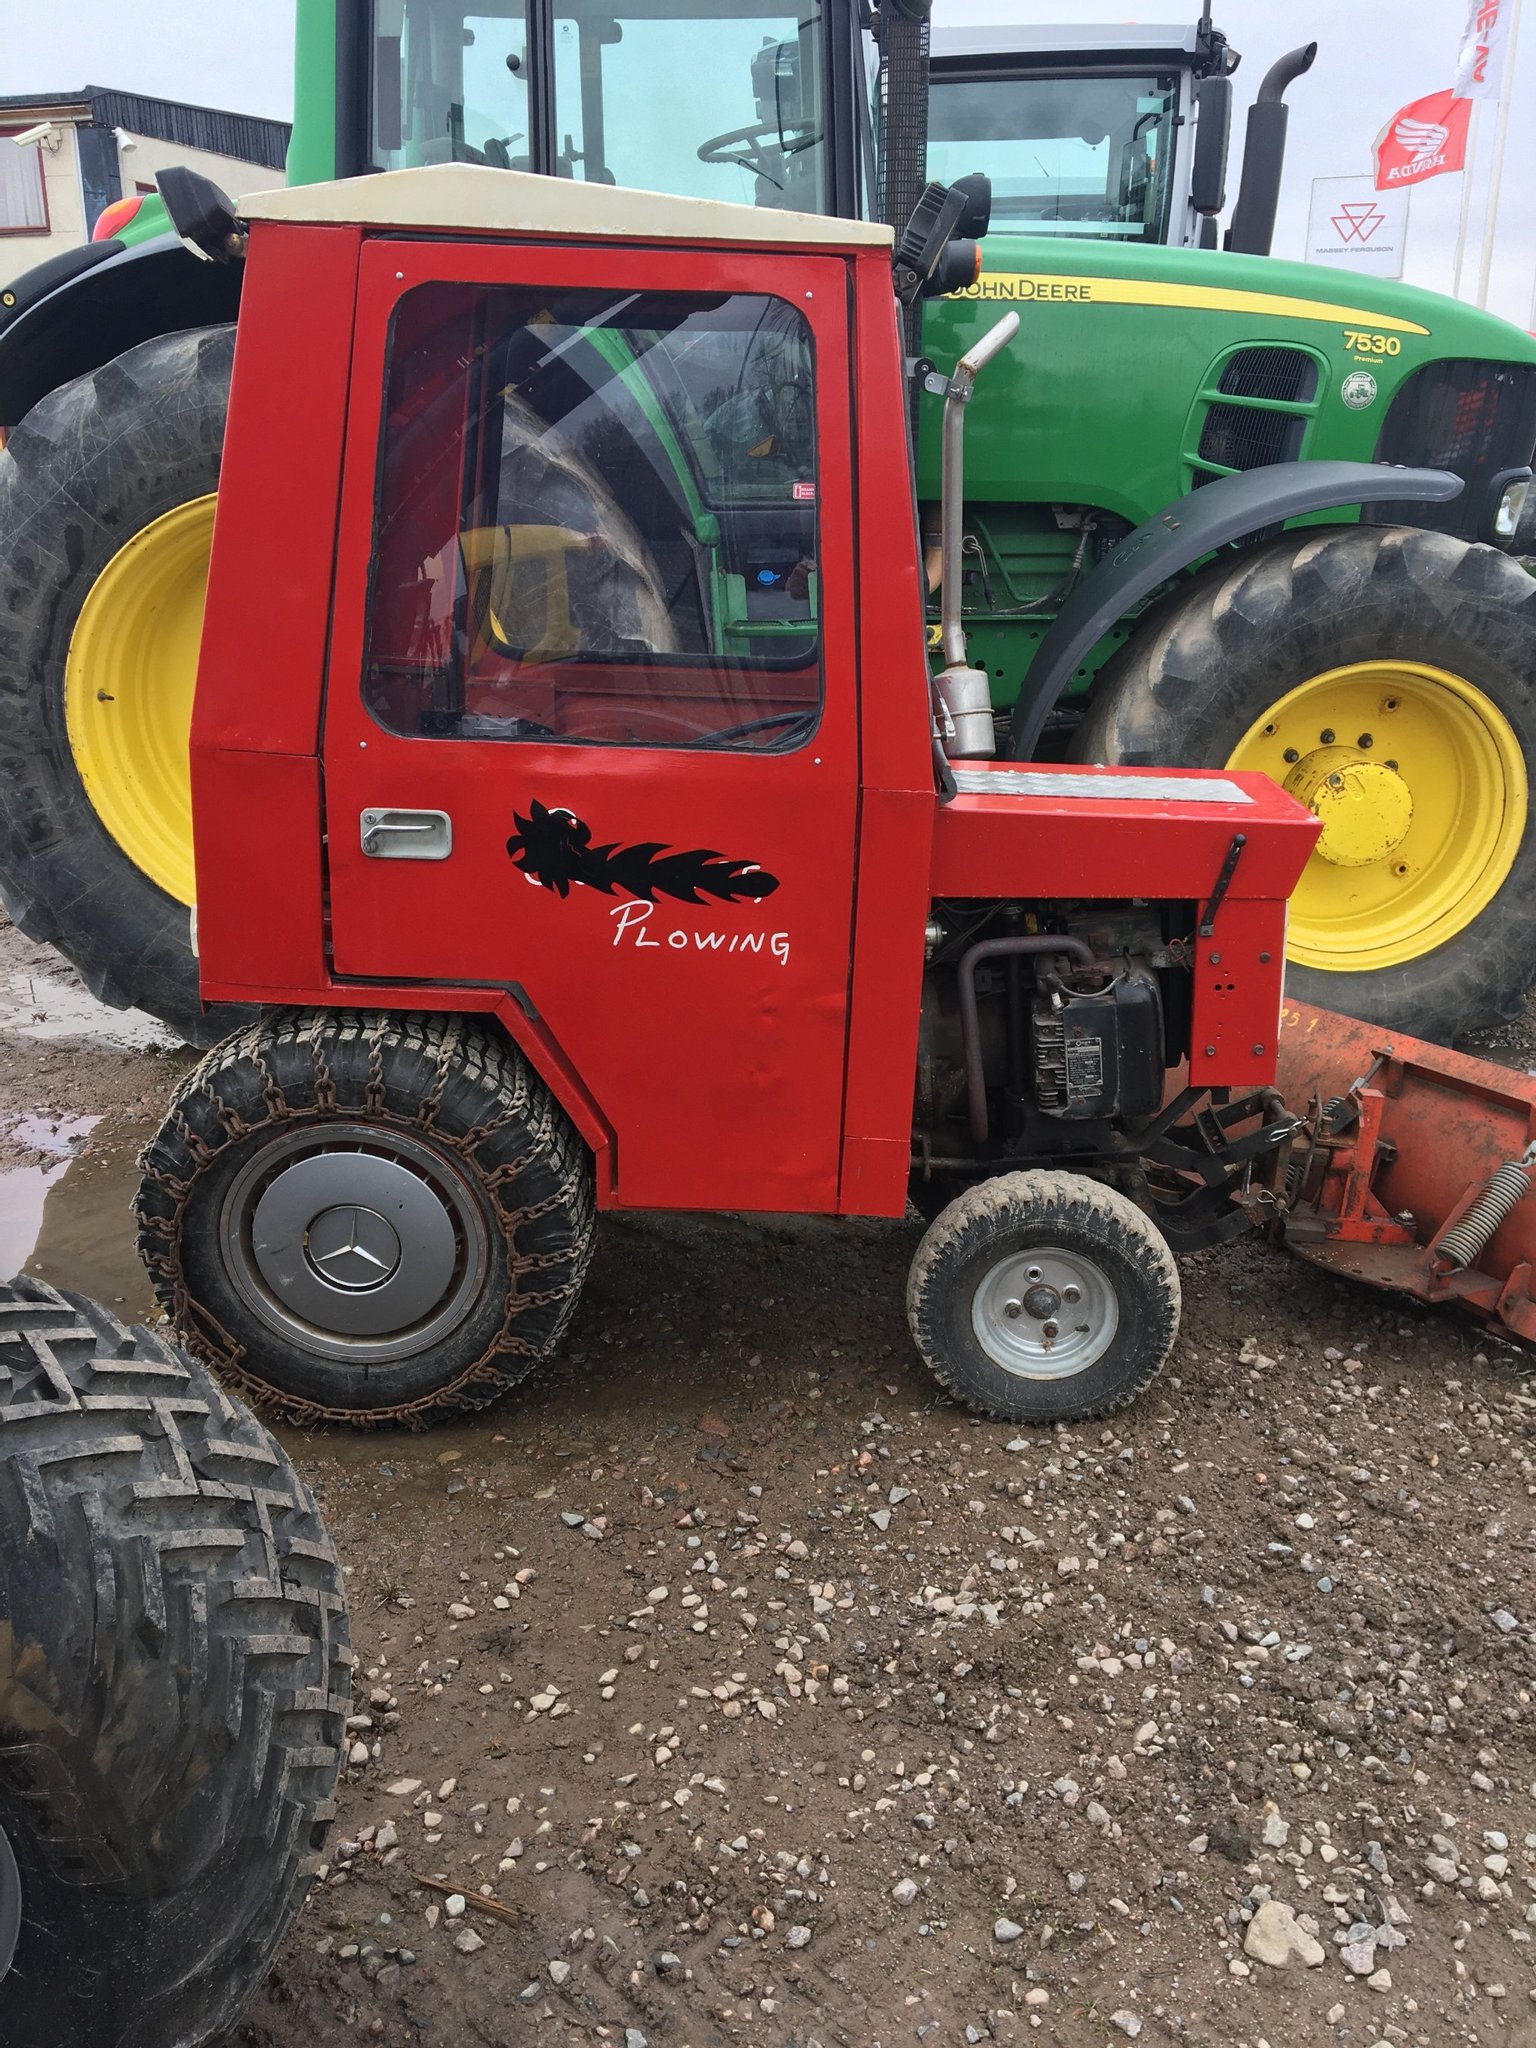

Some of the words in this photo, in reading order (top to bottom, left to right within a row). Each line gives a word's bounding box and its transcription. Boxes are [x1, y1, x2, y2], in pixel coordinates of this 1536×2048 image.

[1019, 279, 1092, 299] DEERE
[1343, 330, 1401, 356] 7530
[1353, 355, 1384, 364] Premium
[610, 899, 790, 965] PLOWING
